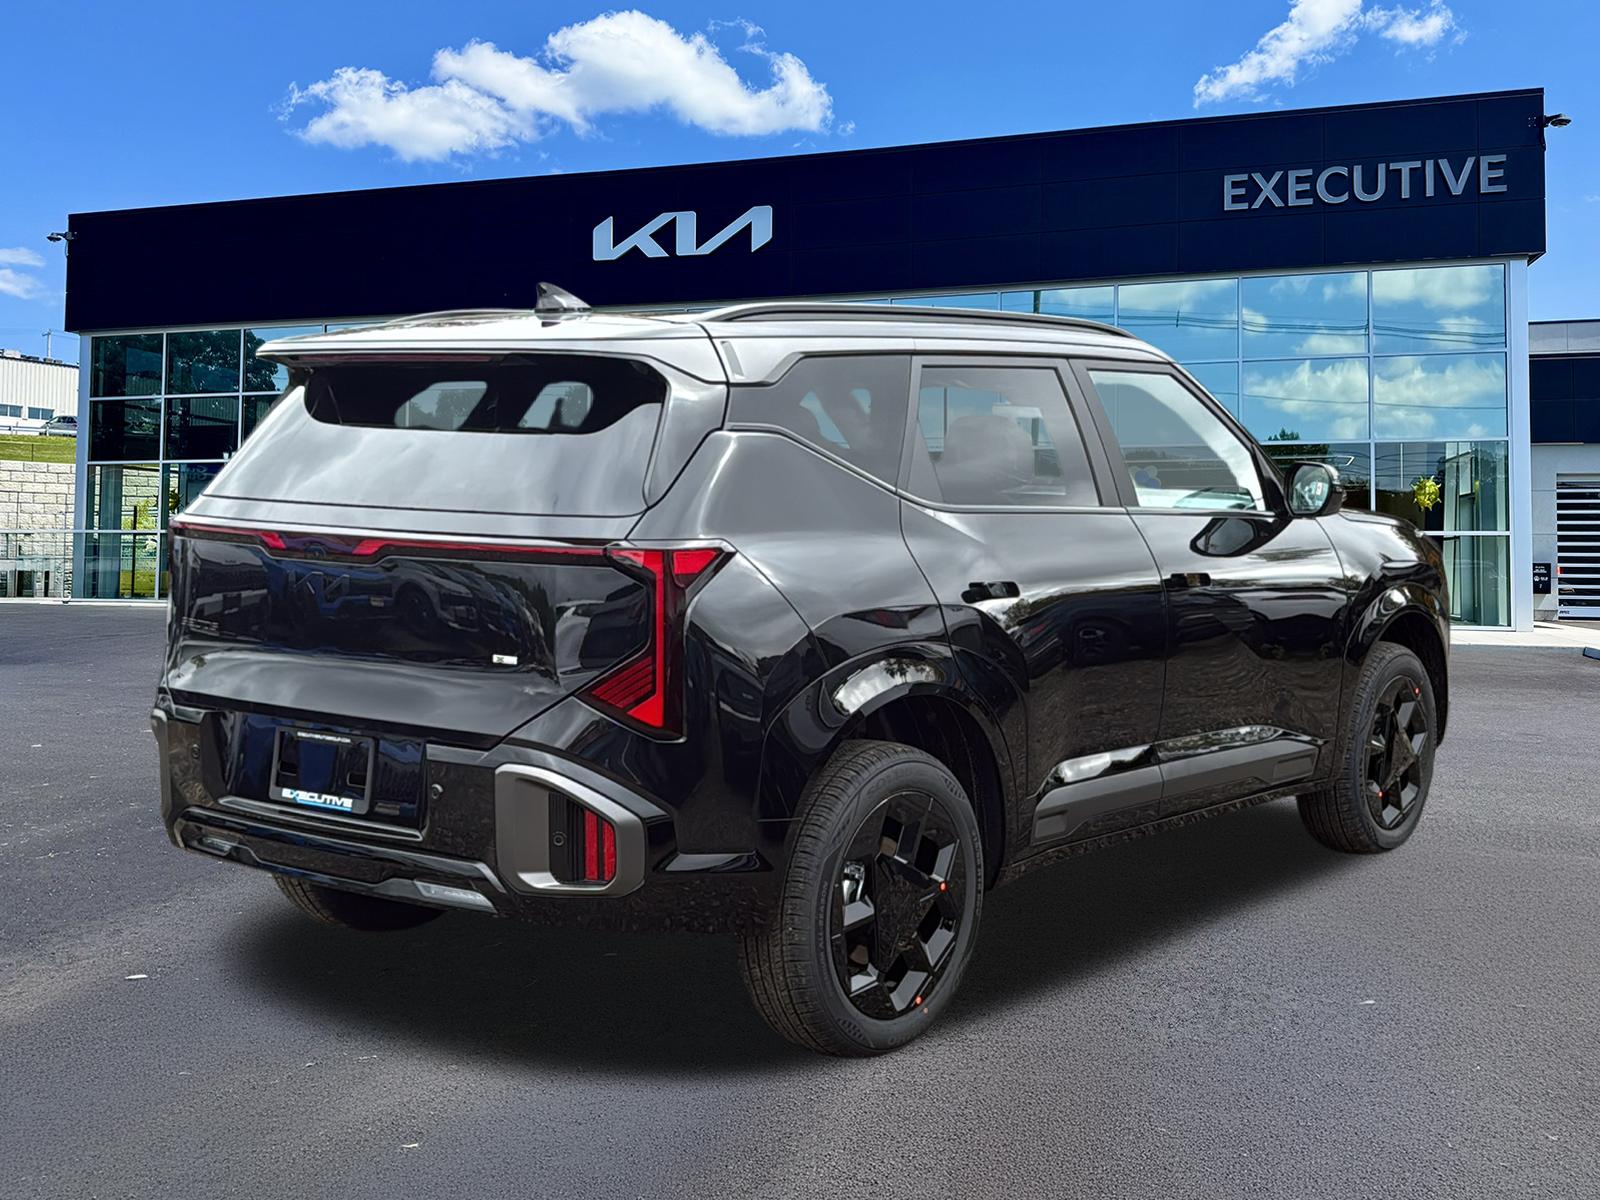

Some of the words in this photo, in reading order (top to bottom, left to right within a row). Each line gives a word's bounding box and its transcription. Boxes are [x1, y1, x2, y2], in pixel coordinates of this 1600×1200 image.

[1223, 154, 1508, 212] EXECUTIVE
[593, 205, 773, 262] KIA
[281, 788, 353, 808] EXECUTIVE
